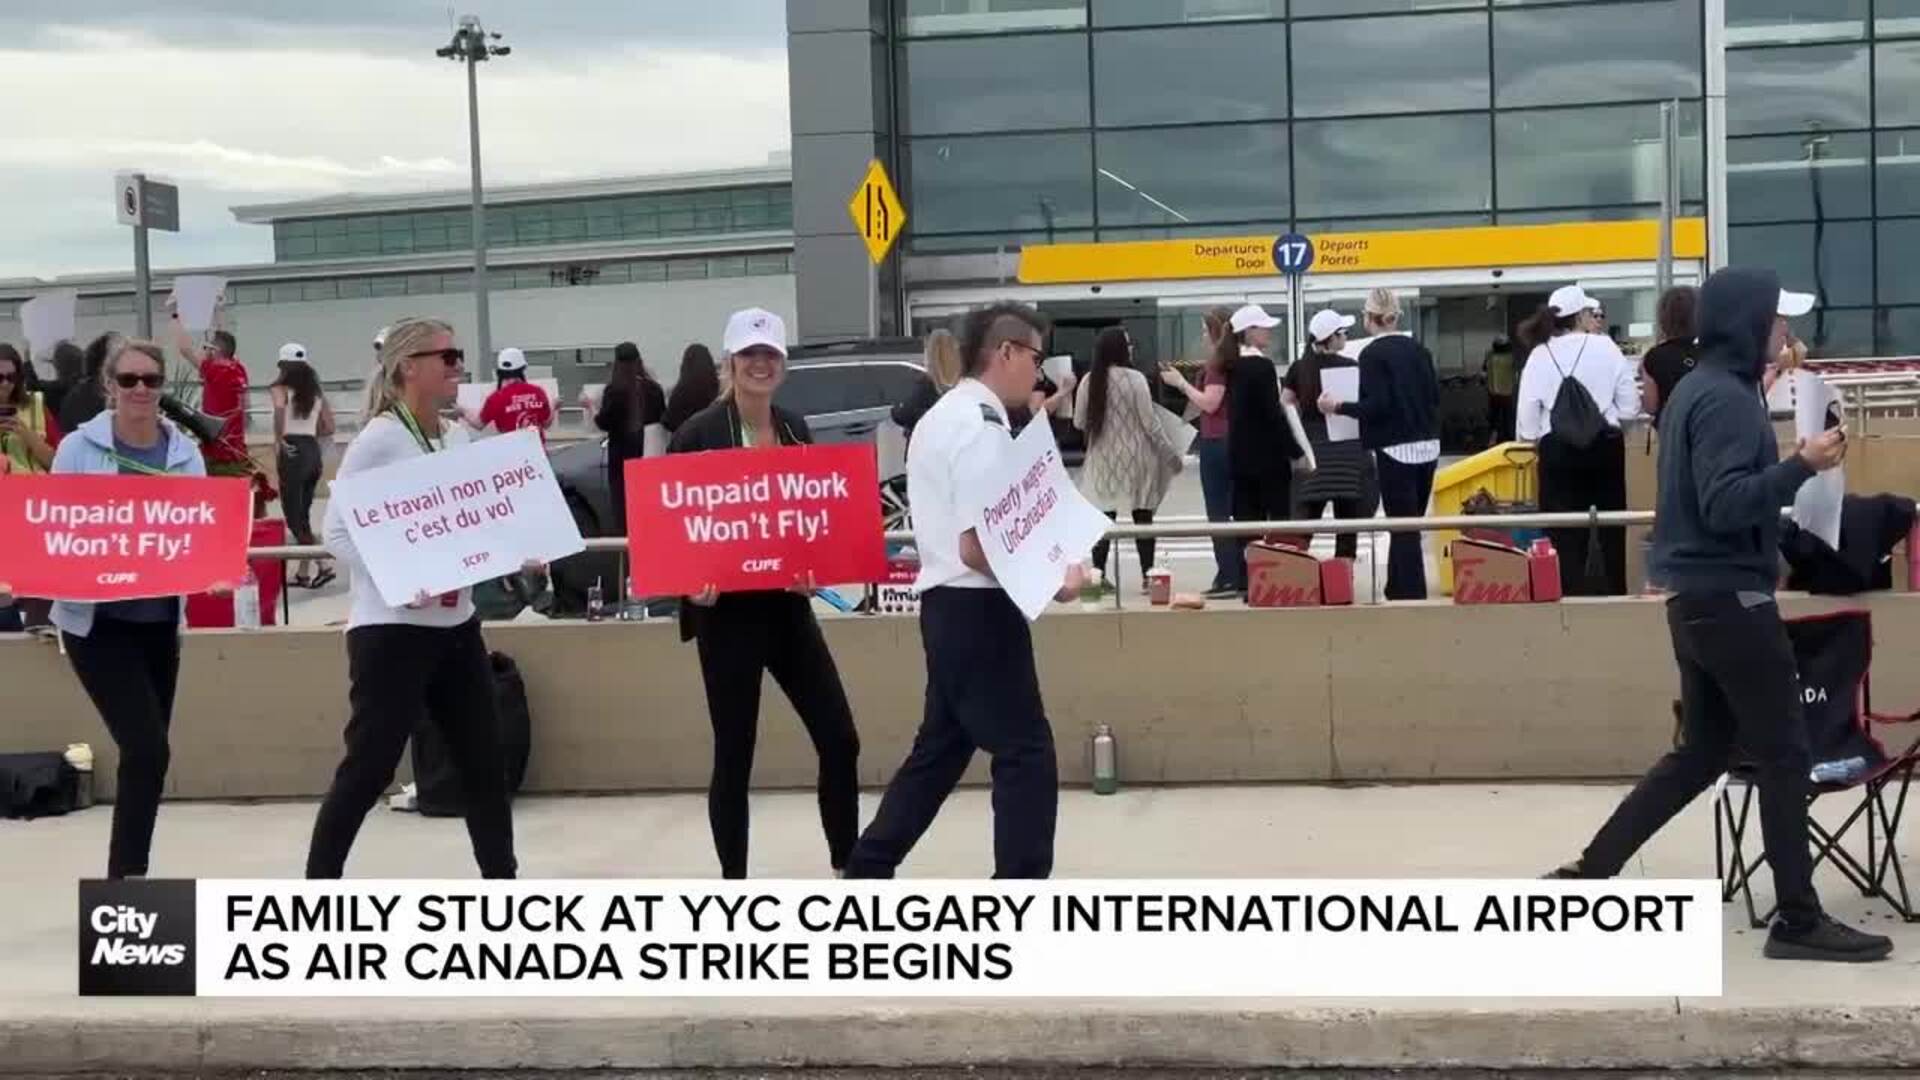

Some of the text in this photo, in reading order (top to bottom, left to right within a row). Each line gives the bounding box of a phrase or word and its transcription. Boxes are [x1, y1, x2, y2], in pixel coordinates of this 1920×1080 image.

[1195, 243, 1266, 257] Departures
[1278, 242, 1307, 267] 17
[1320, 239, 1369, 252] Departs
[1320, 253, 1360, 266] Portes
[1235, 258, 1265, 270] Door
[353, 460, 544, 528] Le travail non payé,
[661, 472, 849, 510] Unpaid Work
[983, 484, 1022, 531] Poverty
[1023, 456, 1046, 496] wages
[25, 498, 216, 528] Unpaid Work
[405, 496, 515, 543] c'est du vol
[684, 509, 829, 543] Won't Fly!
[1001, 487, 1059, 554] UnCanadian
[44, 531, 192, 561] Won't Fly!
[97, 572, 139, 585] CUPE
[742, 558, 783, 573] CUPE
